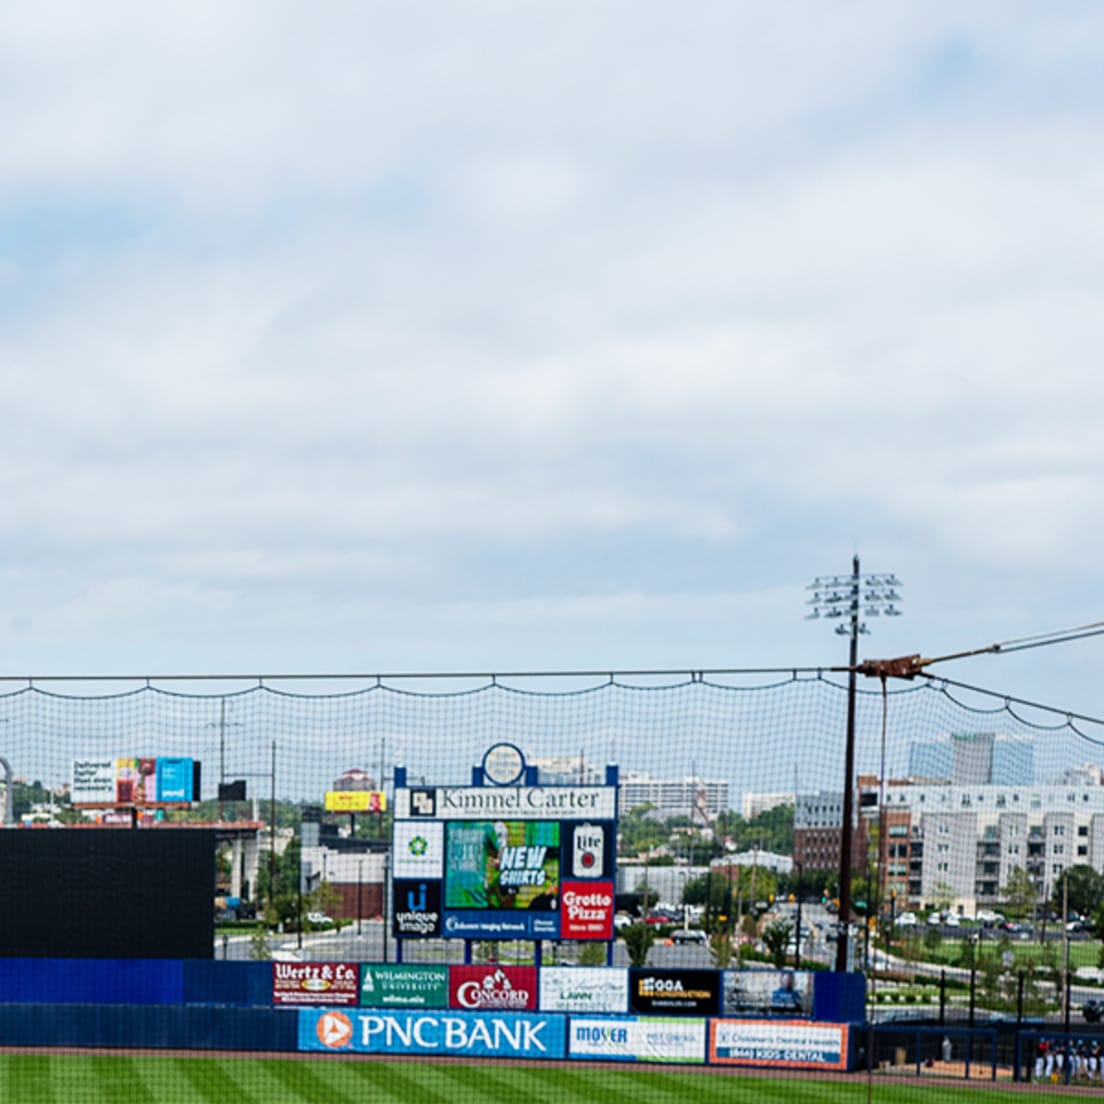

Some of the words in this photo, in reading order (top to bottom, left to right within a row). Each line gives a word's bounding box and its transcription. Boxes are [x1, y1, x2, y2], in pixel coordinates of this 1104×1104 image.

[441, 789, 521, 809] Kimmel
[526, 788, 600, 809] Carter
[577, 835, 602, 850] Lite
[499, 846, 547, 871] NEW
[499, 870, 546, 886] SHIRTS
[562, 891, 612, 908] Grotto
[396, 911, 439, 925] unique
[567, 905, 607, 921] Pizza
[399, 921, 436, 935] image
[274, 963, 320, 980] Wertz
[321, 964, 333, 980] &
[374, 971, 446, 982] WILMINGTON
[381, 982, 440, 991] UNIVERSITY
[456, 980, 529, 1009] CONCORD
[358, 1015, 439, 1048] PNC
[441, 1017, 547, 1051] BANK
[731, 1034, 775, 1044] Children's
[776, 1035, 807, 1045] Dental
[808, 1037, 841, 1047] Health
